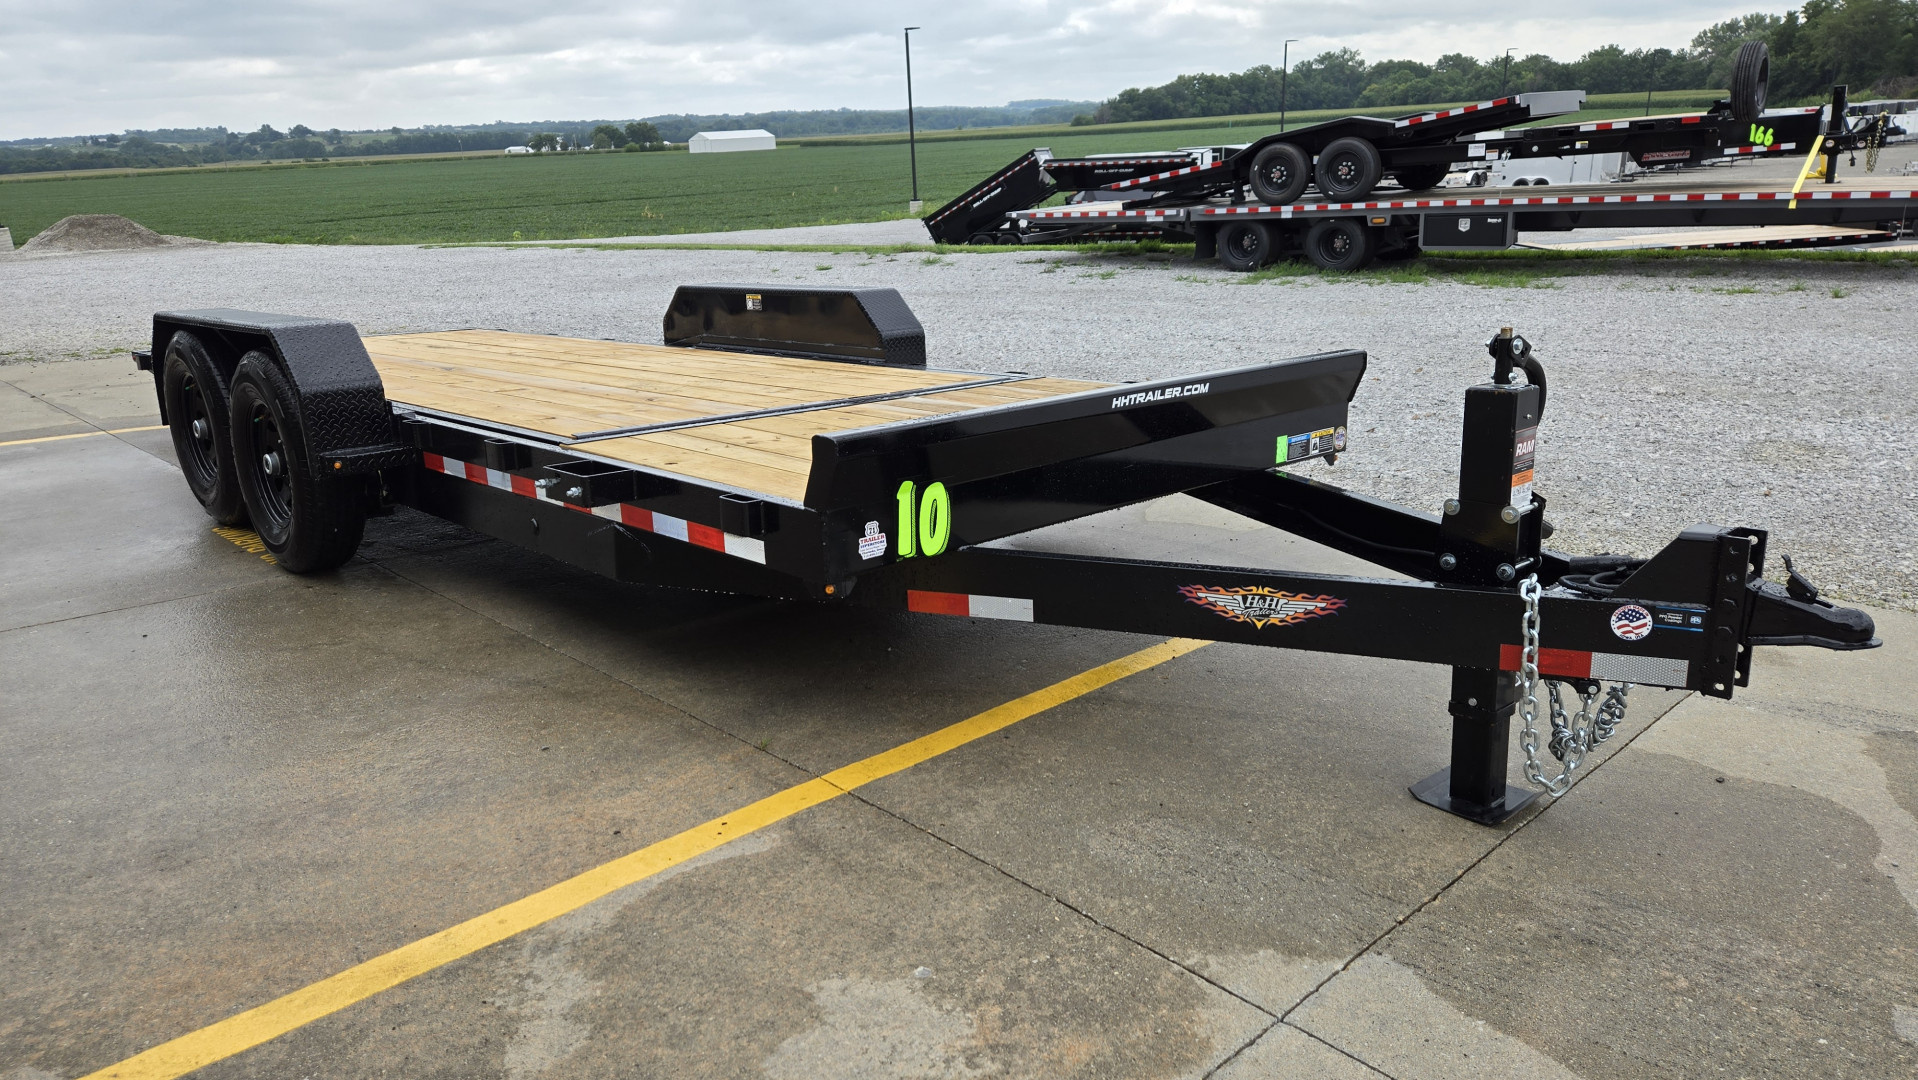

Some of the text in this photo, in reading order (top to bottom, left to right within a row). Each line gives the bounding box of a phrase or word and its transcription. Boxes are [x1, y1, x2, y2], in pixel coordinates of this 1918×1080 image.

[1749, 123, 1774, 147] 166
[1111, 382, 1211, 409] HHTRAILER.COM
[1516, 439, 1535, 457] RAM
[896, 480, 952, 558] 10
[860, 534, 885, 545] TRAILER
[1244, 595, 1279, 609] H&H
